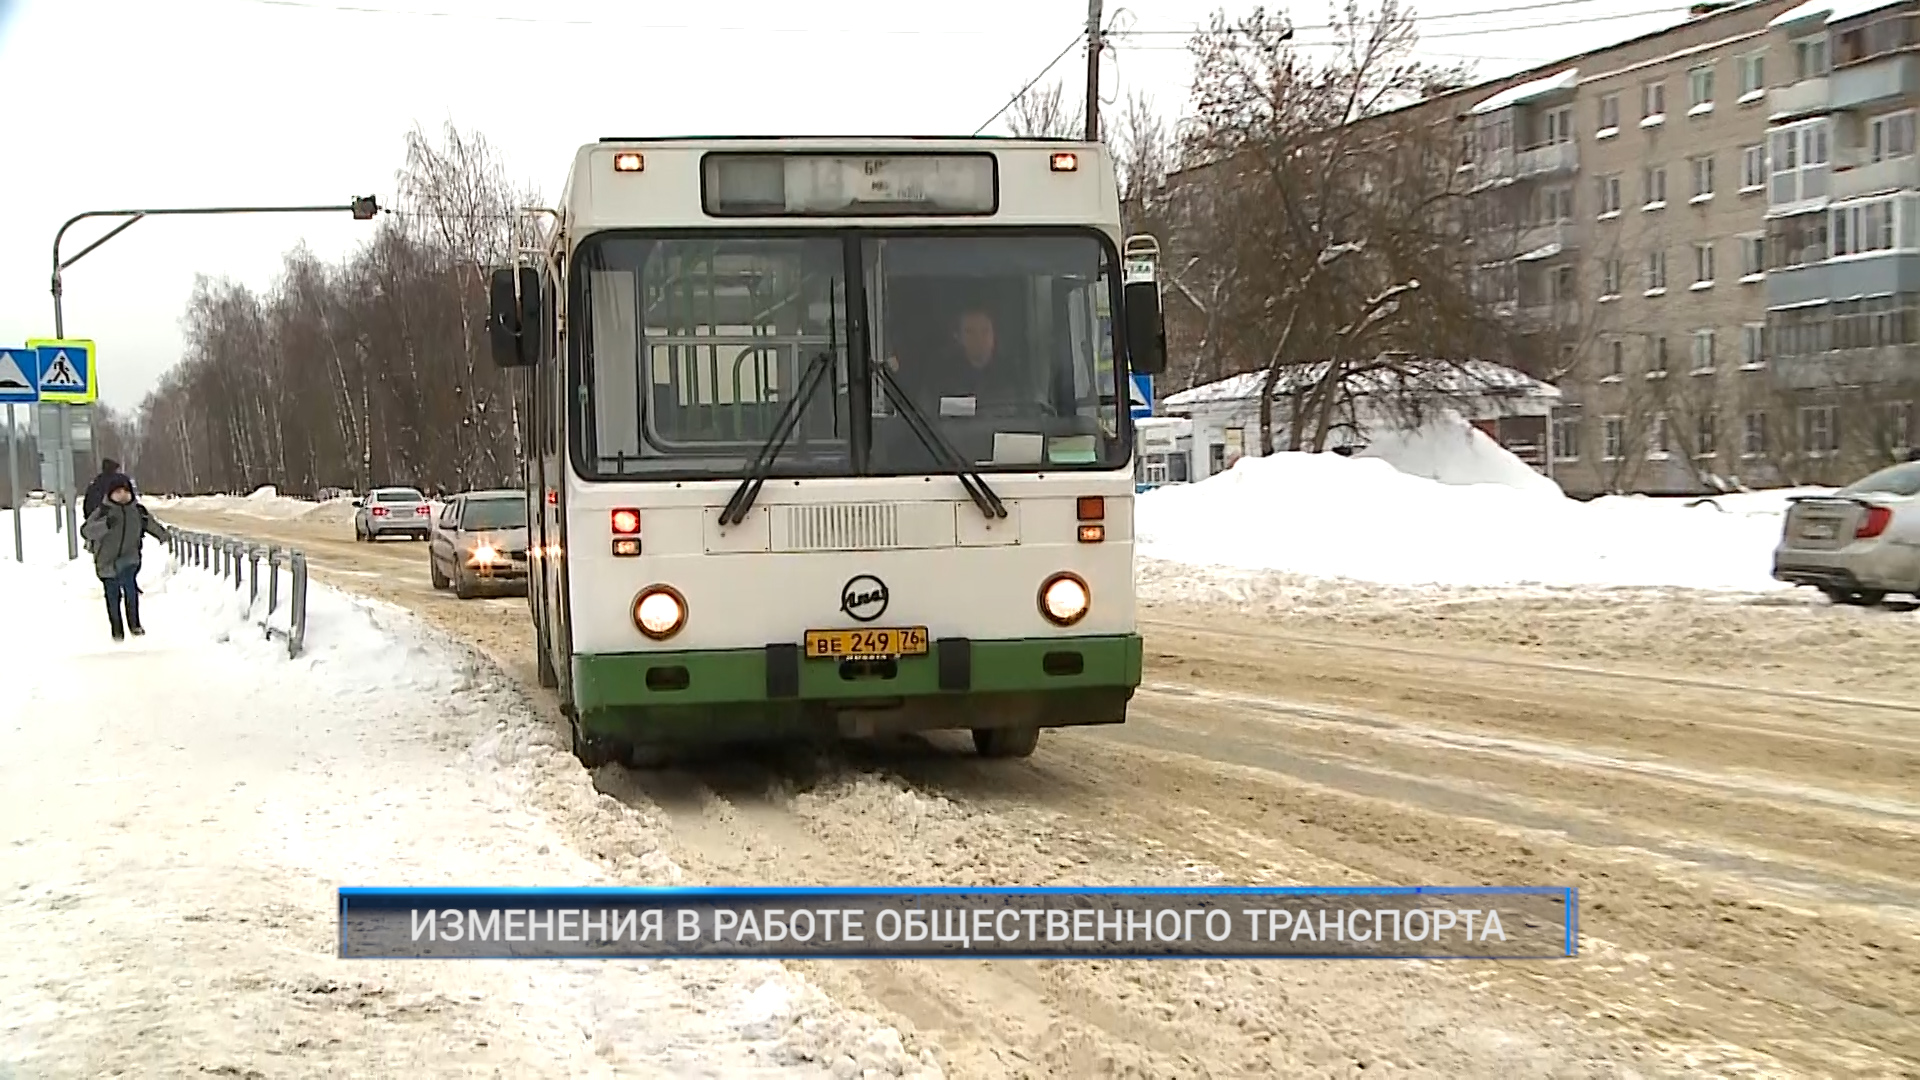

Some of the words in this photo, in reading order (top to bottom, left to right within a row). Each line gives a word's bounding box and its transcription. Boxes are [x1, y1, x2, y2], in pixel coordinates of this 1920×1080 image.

[817, 637, 842, 654] ВЕ
[850, 632, 889, 652] 249
[900, 631, 920, 645] 76
